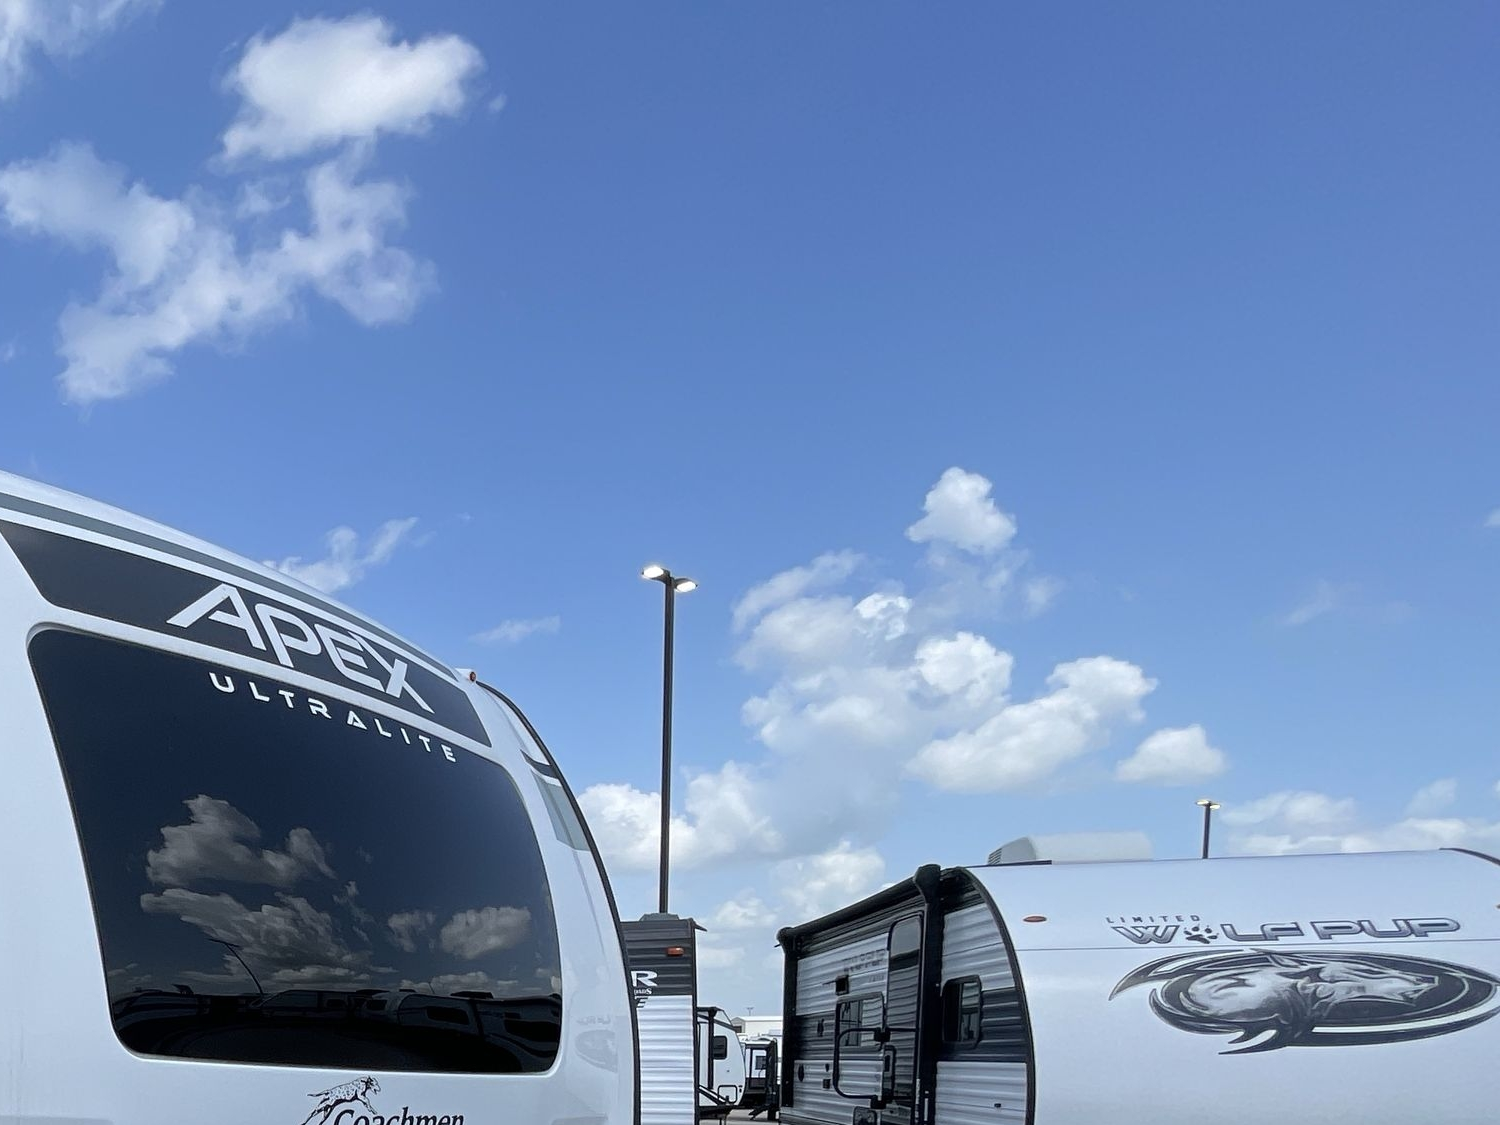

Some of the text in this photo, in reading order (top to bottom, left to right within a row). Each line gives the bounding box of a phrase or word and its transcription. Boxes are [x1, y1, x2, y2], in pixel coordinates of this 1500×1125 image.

[166, 583, 435, 714] APEX
[209, 672, 457, 763] ULTRALITE
[1105, 914, 1201, 924] LIMITED
